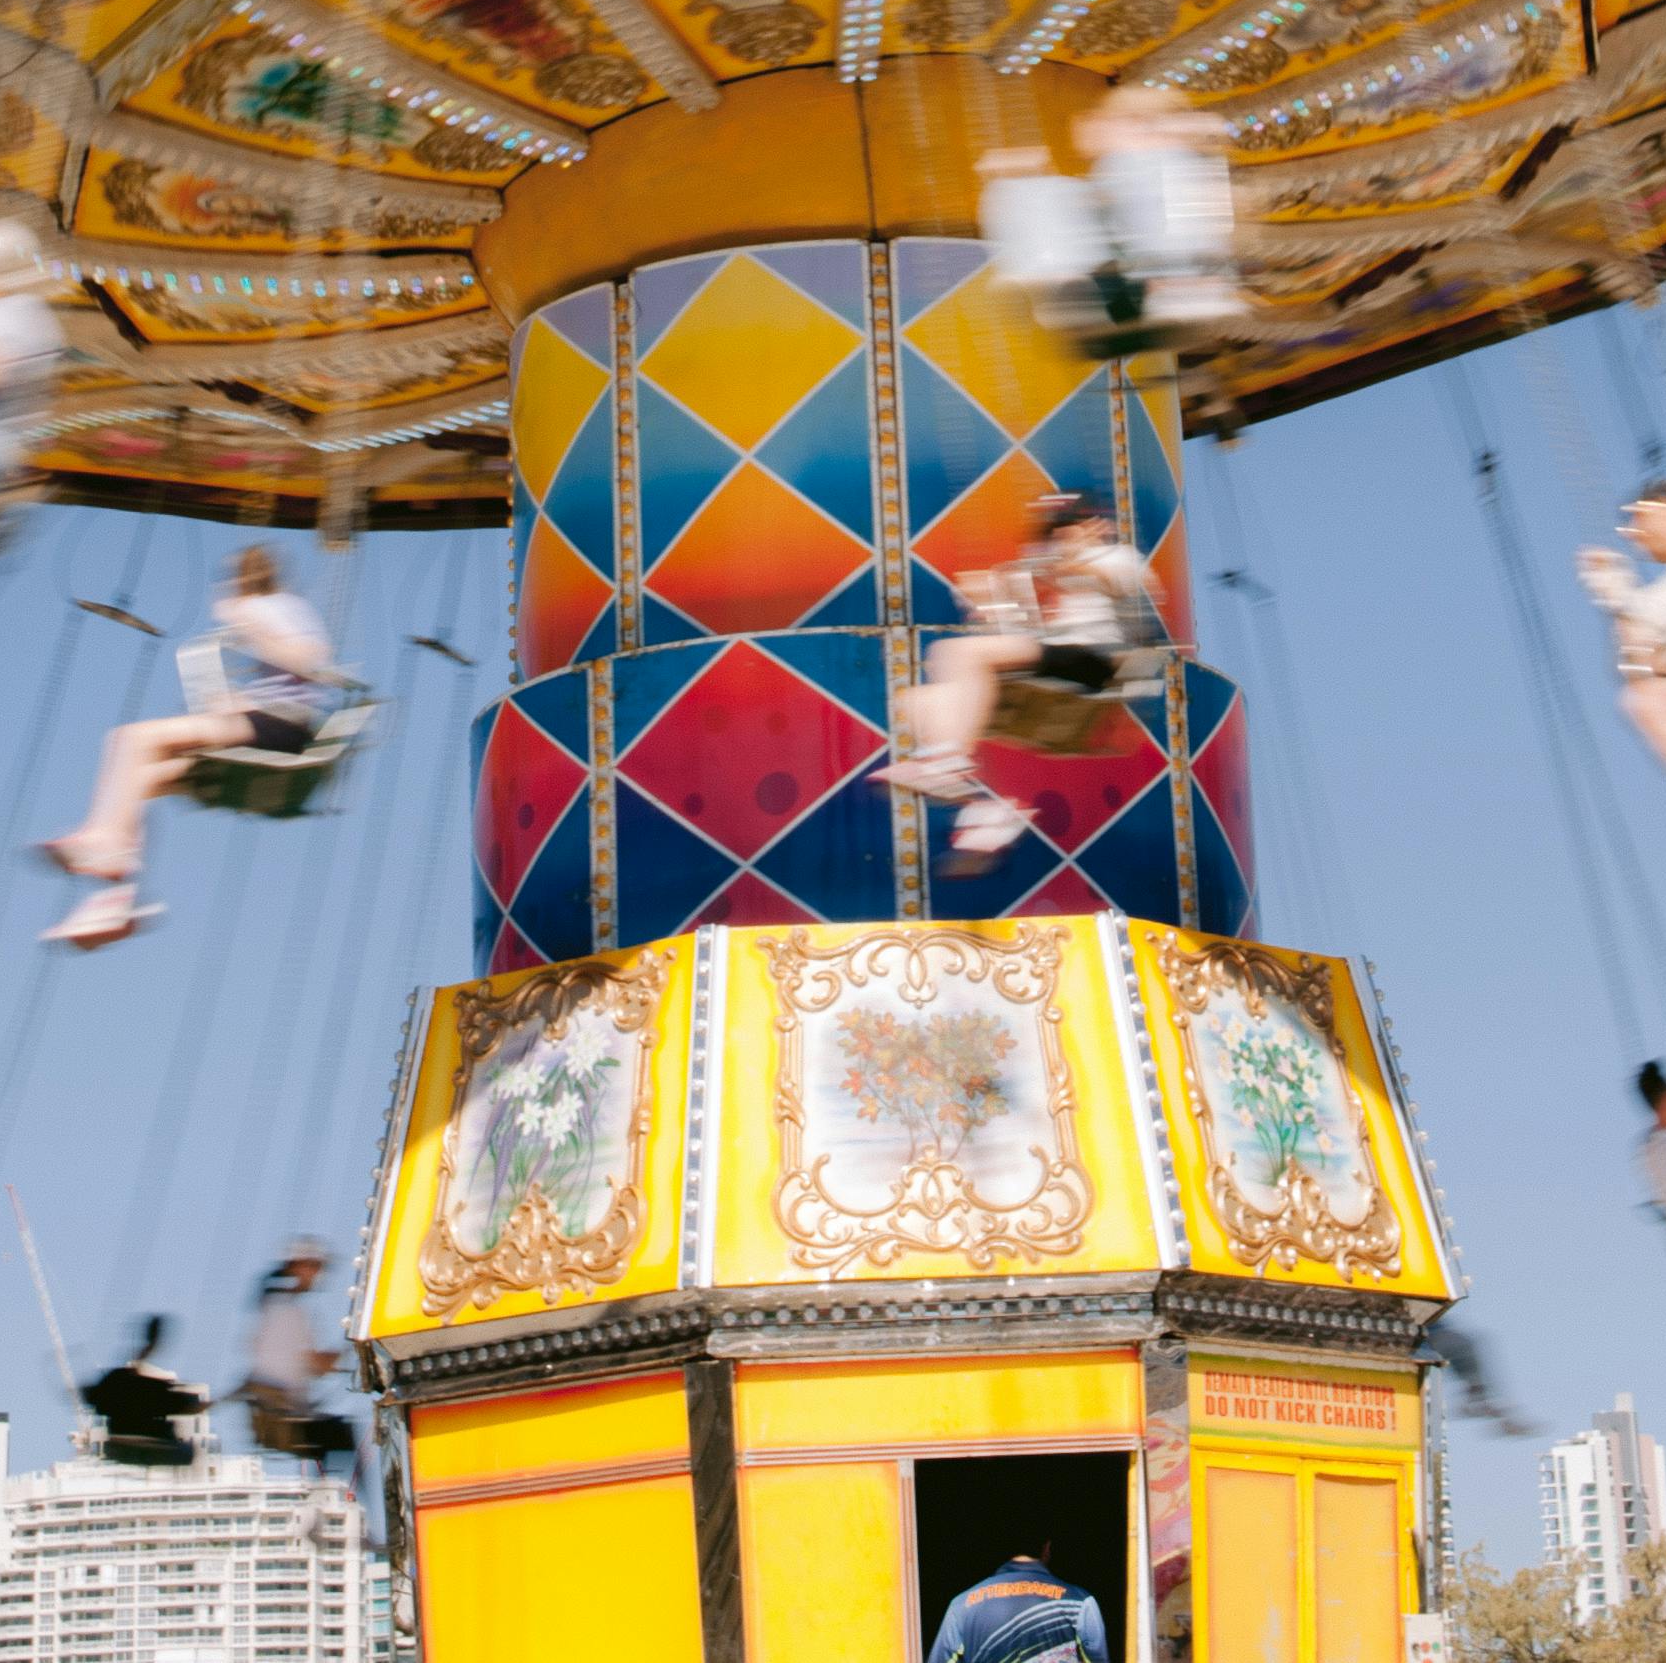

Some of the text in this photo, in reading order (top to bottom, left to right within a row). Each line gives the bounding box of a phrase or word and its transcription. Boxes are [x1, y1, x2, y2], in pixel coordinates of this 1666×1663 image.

[1205, 1371, 1396, 1409] REMAIN SEATED UNTIL RIDE STOPS
[1206, 1396, 1228, 1417] DO
[1235, 1398, 1268, 1420] NOT
[1275, 1401, 1316, 1424] KICK
[965, 1581, 1067, 1607] ATTENDANT
